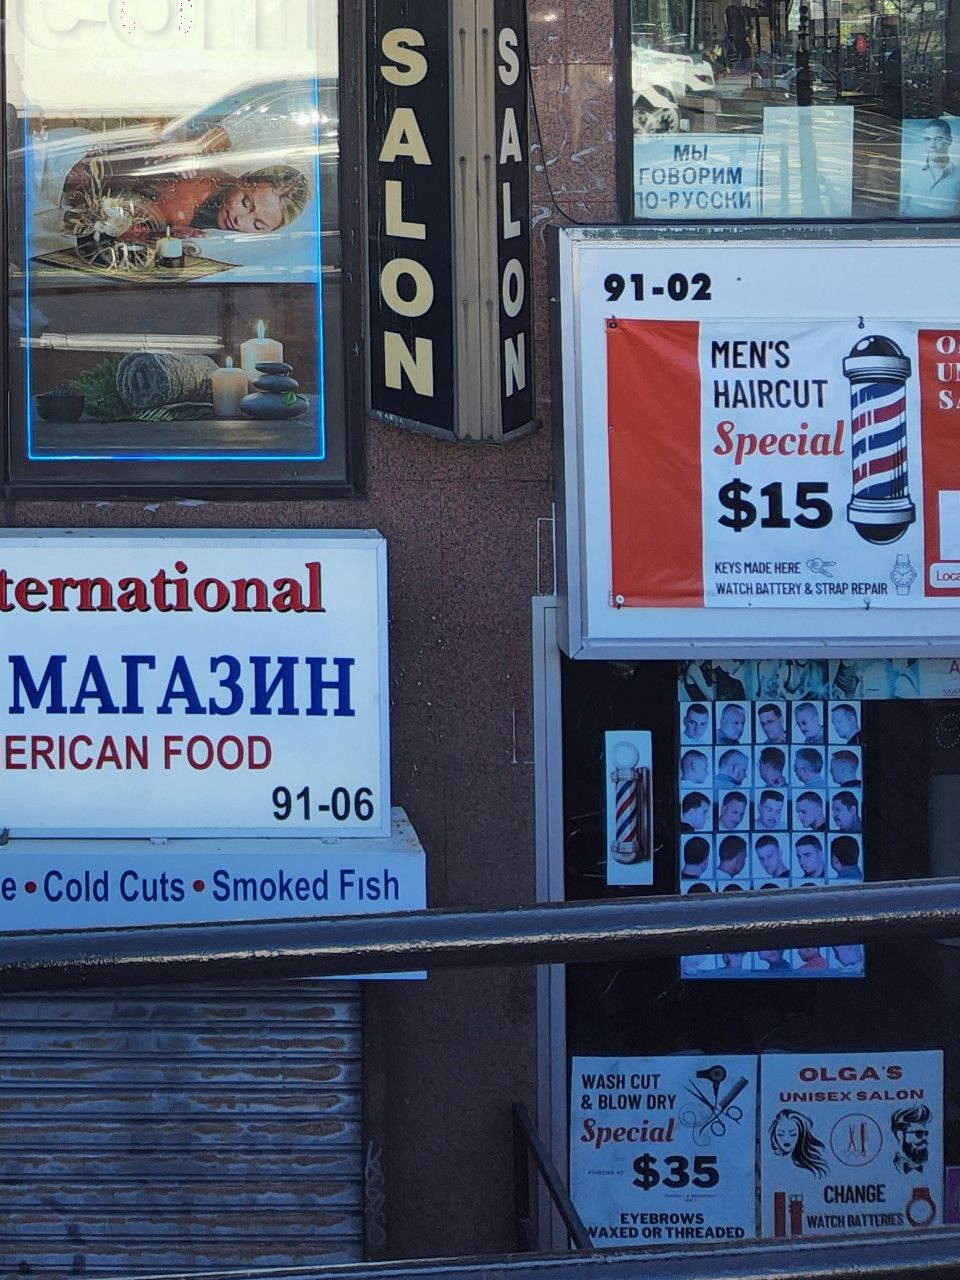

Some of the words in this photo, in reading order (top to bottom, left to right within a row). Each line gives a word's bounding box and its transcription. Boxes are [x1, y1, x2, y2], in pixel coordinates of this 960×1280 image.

[674, 144, 708, 161] МЫ
[639, 166, 742, 185] ГОВОРИМ
[379, 27, 434, 398] SALON
[497, 27, 526, 398] SALON
[604, 273, 712, 302] 91-02
[711, 340, 790, 368] MEN'S
[936, 335, 960, 355] O
[713, 379, 828, 409] HAIRCUT
[938, 389, 960, 410] S
[713, 420, 844, 465] Special
[718, 478, 833, 532] $15
[715, 562, 741, 574] KEYS
[744, 562, 772, 574] MADE
[774, 562, 801, 574] HERE
[716, 582, 753, 595] WATCH
[756, 582, 801, 595] BATTERY
[804, 583, 813, 594] &
[816, 583, 848, 595] STRAP
[852, 583, 888, 595] REPAIR
[8, 655, 355, 716] МАГАЗИН
[164, 735, 272, 770] FOOD
[272, 786, 374, 821] 91-06
[43, 870, 109, 902] Cold
[119, 870, 185, 902] Cuts
[212, 869, 328, 902] Smoked
[340, 869, 400, 901] Fish
[581, 1074, 627, 1090] WASH
[631, 1073, 661, 1089] CUT
[799, 1065, 903, 1082] OLGA'S
[581, 1095, 593, 1110] &
[598, 1094, 642, 1110] BLOW
[646, 1094, 677, 1110] DRY
[779, 1091, 852, 1103] UNISEX
[856, 1089, 924, 1102] SALON
[580, 1118, 675, 1149] Special
[633, 1153, 720, 1191] $35
[823, 1184, 886, 1204] CHANGE
[620, 1213, 705, 1225] EYEBROWS
[806, 1215, 845, 1229] WATCH
[848, 1212, 905, 1228] BATTERIES
[642, 1227, 662, 1239] OR
[665, 1227, 745, 1239] THREADED
